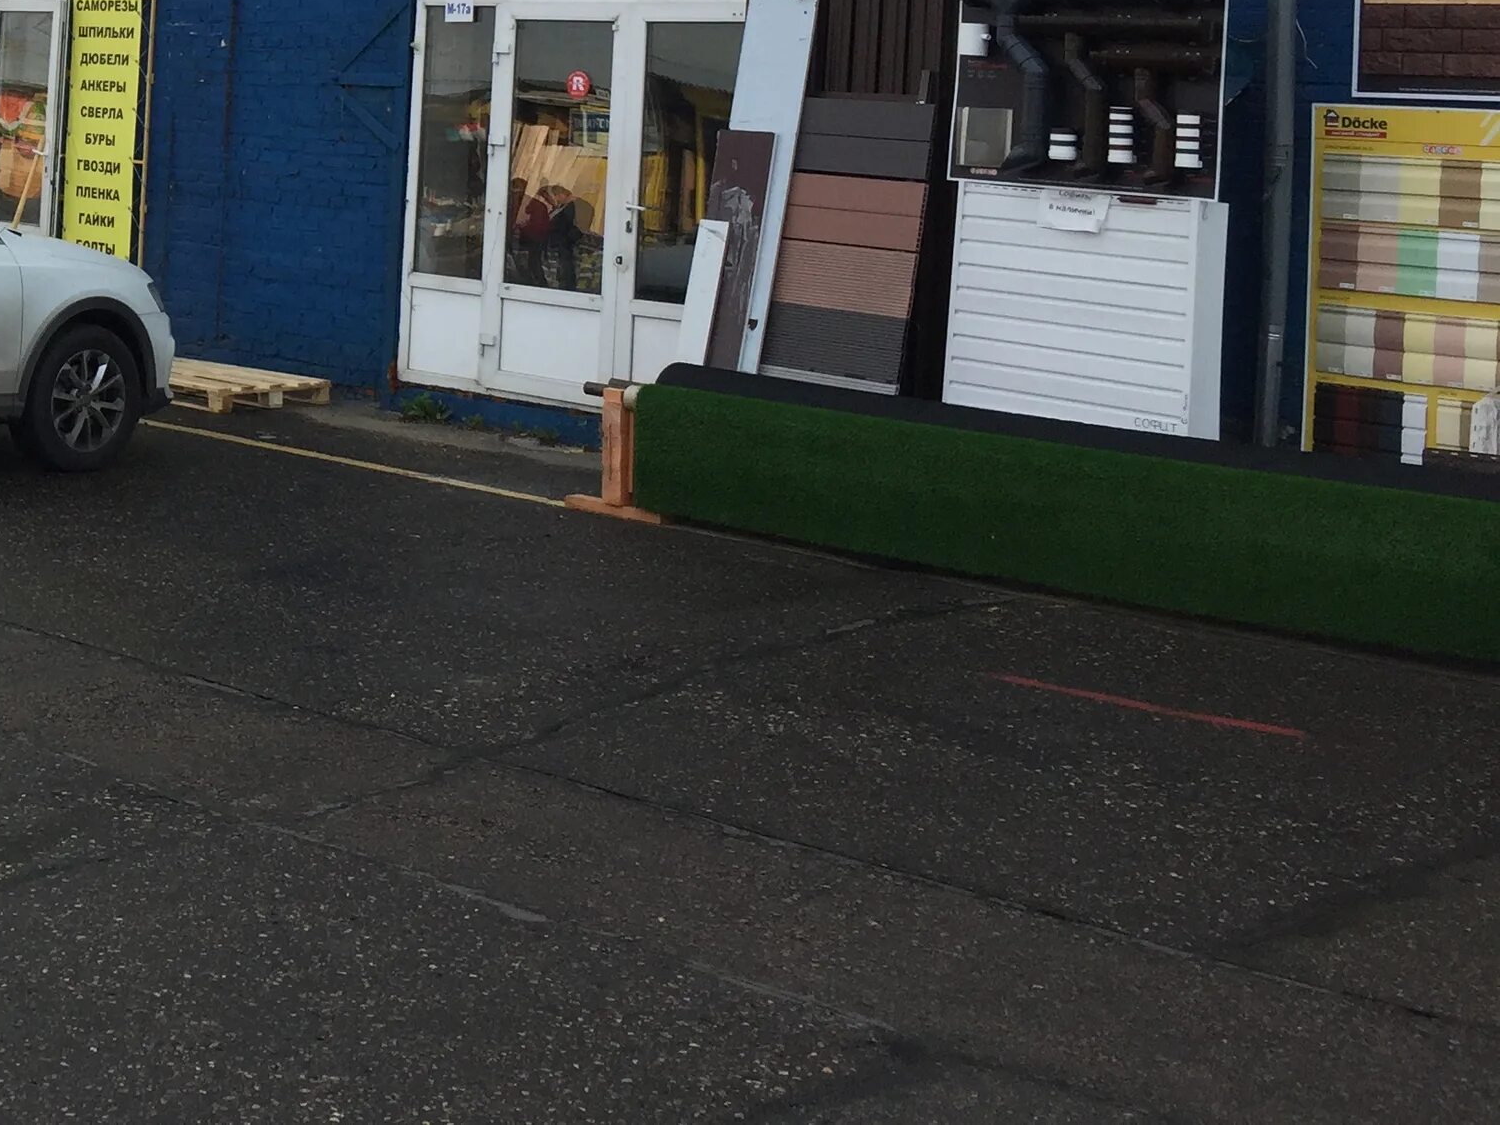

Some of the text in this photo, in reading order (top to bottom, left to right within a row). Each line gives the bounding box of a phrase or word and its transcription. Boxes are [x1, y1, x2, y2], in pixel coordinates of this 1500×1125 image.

[76, 0, 139, 12] САМОРЕЗЫ
[78, 26, 135, 39] ШПИЛЬКИ
[80, 52, 130, 67] ДЮБЕЛИ
[80, 79, 126, 93] АНКЕРЫ
[80, 105, 124, 120] СВЕРЛА
[1341, 117, 1388, 130] Döcke
[84, 132, 116, 146] БУРЫ
[77, 159, 121, 175] ГВОЗДИ
[76, 186, 120, 201] ПЛЕНКА
[78, 212, 115, 228] ГАЙКИ
